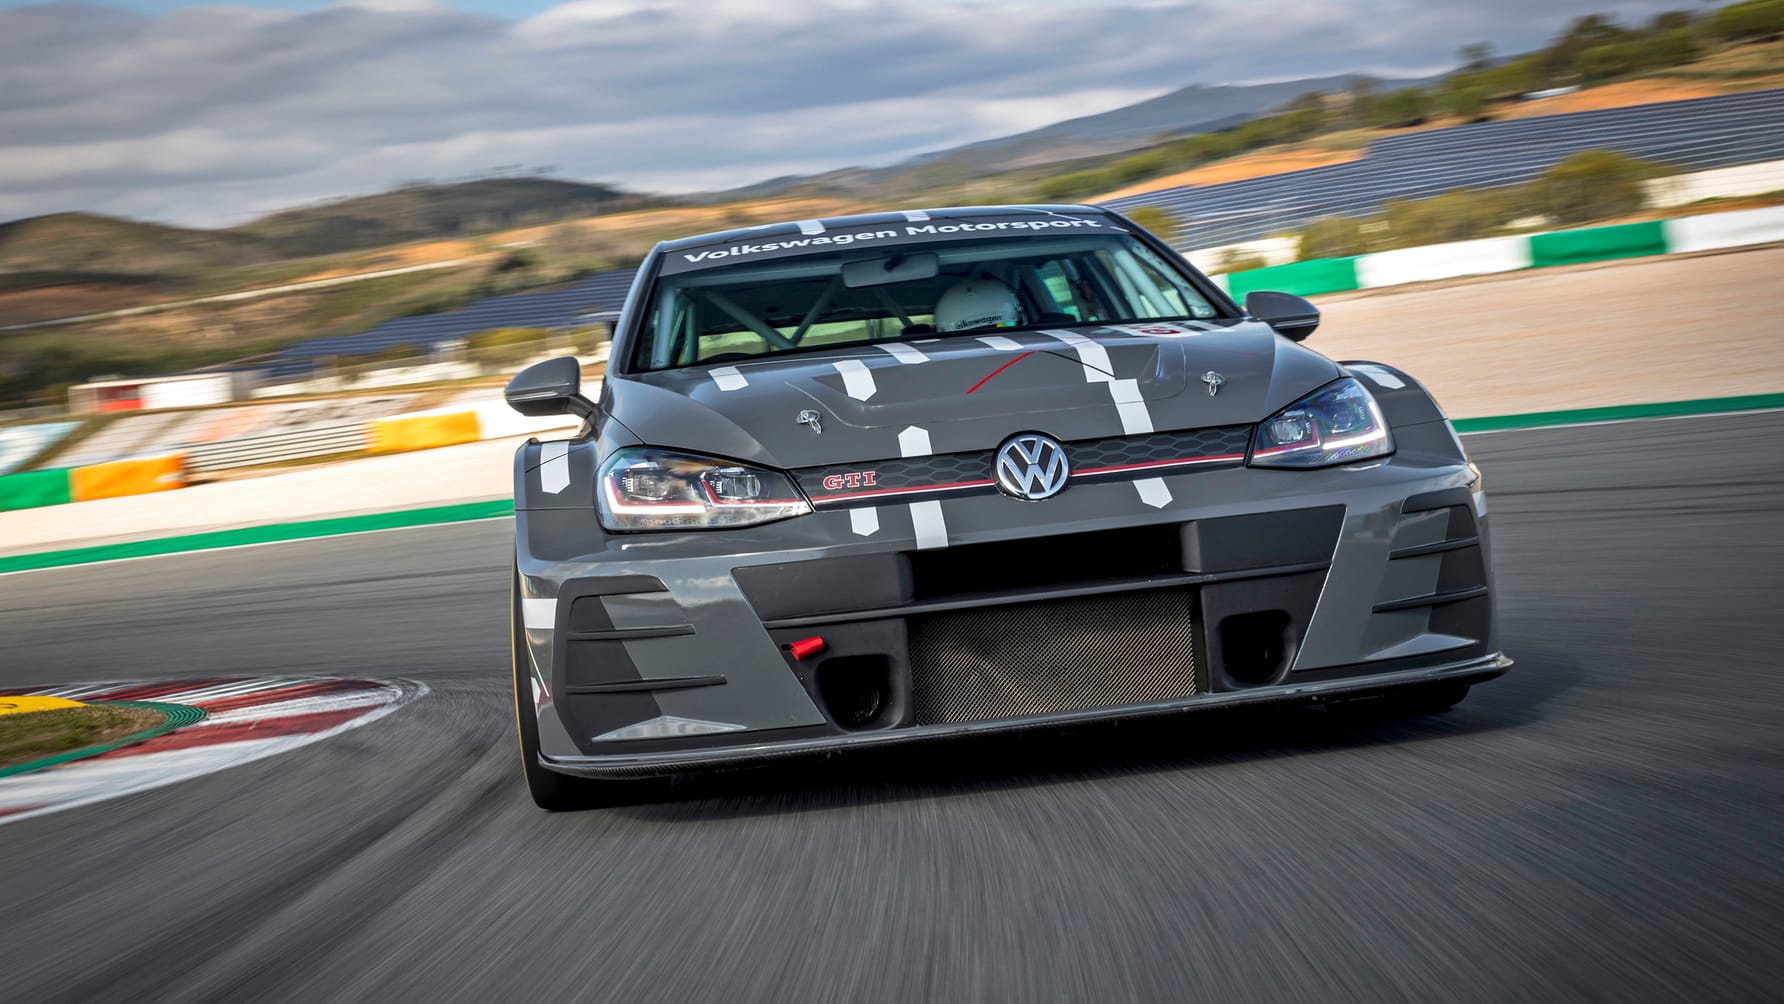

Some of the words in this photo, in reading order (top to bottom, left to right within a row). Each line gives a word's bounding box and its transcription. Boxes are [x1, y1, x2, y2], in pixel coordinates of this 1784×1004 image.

[684, 229, 897, 263] Volkswagen
[907, 218, 1101, 236] Motorsport
[954, 315, 1002, 329] olkswagen
[823, 472, 876, 490] GTI
[997, 435, 1069, 499] VW
